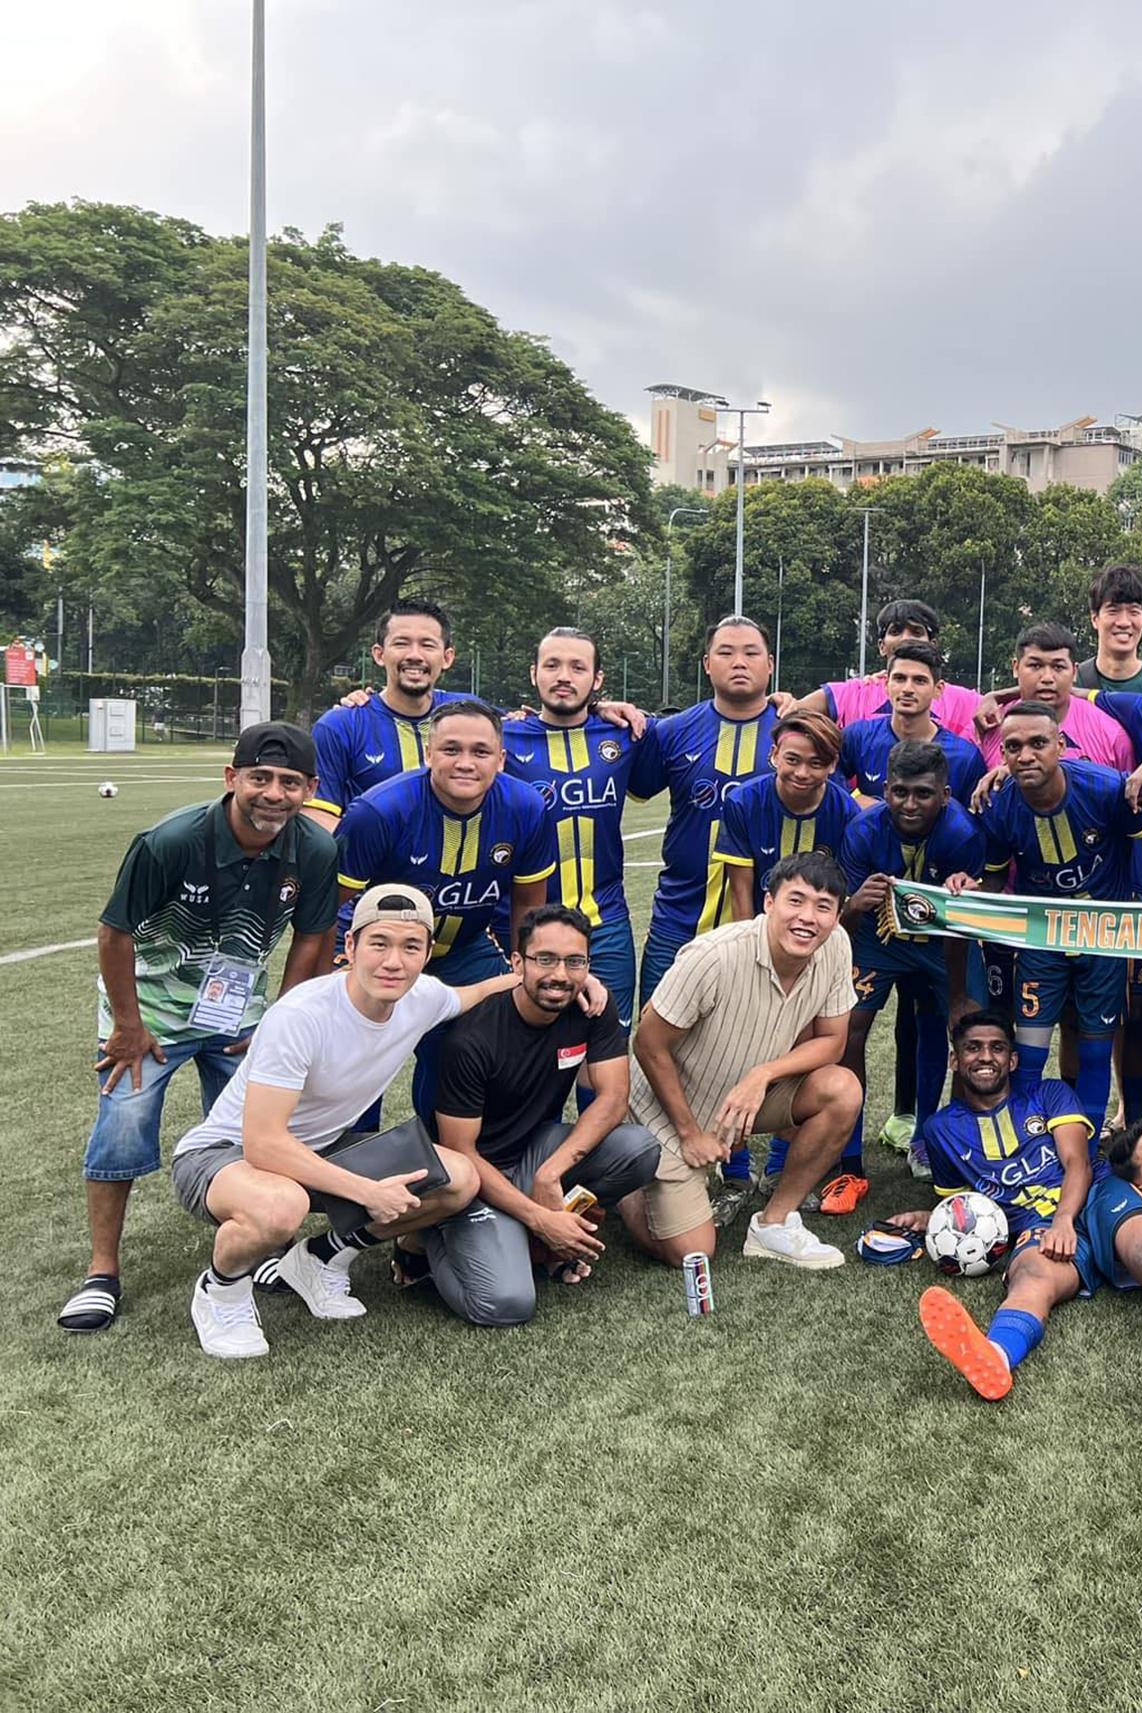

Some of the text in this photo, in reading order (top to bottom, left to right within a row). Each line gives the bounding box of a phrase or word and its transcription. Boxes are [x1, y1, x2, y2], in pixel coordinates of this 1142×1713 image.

[561, 776, 617, 805] GLA
[438, 880, 500, 907] GLA
[987, 964, 1003, 996] 6
[1021, 981, 1041, 1018] 5
[1001, 1145, 1057, 1186] GLA
